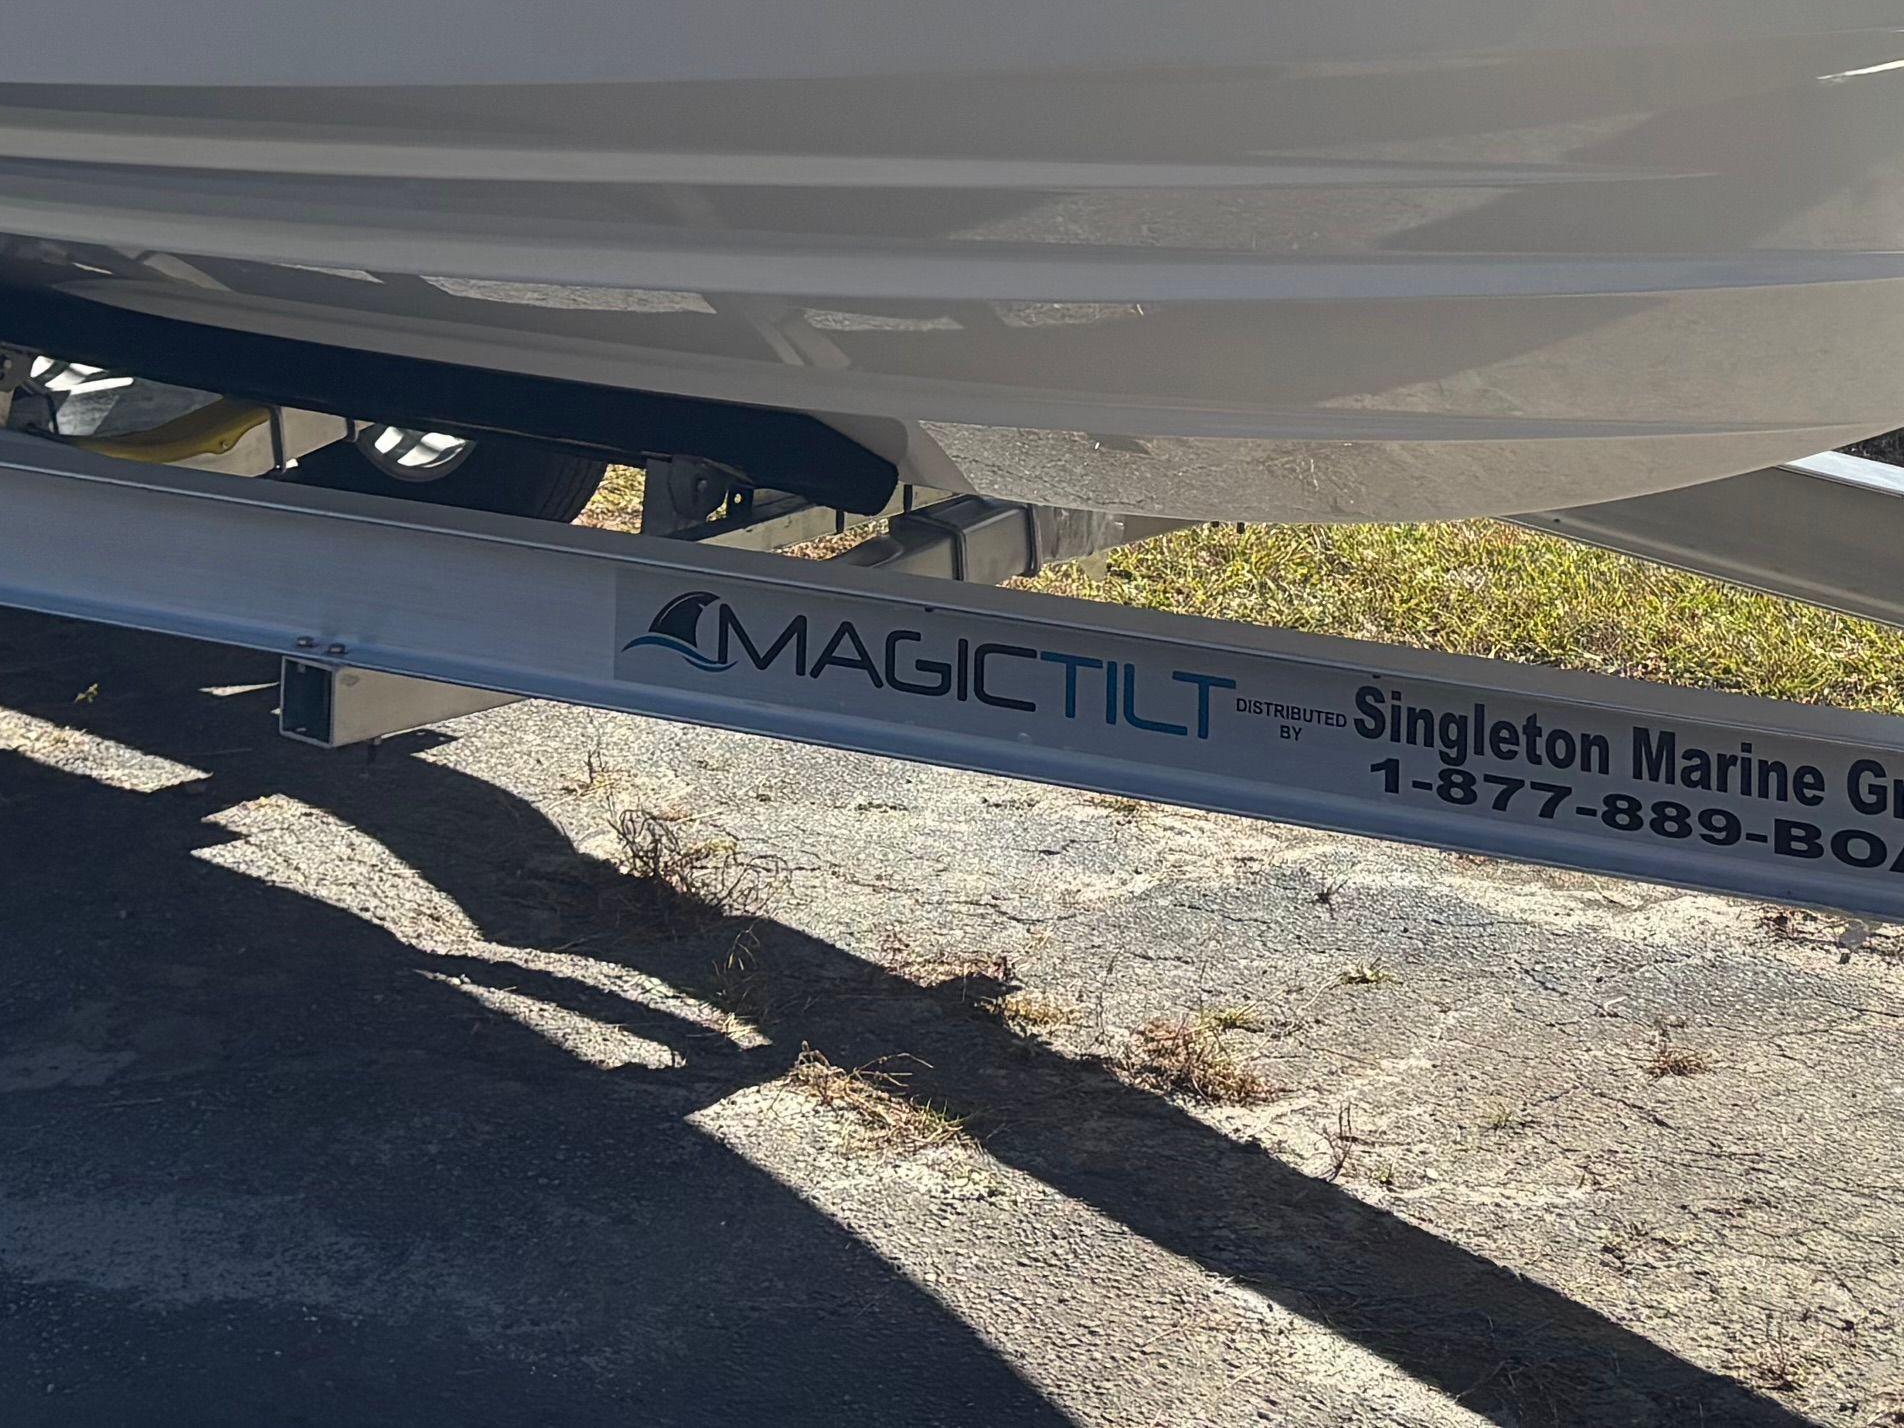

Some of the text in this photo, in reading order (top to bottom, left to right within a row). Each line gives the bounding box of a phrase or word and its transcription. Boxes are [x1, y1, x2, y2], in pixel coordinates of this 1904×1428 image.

[717, 602, 1237, 740] MAGICTILT
[1235, 697, 1348, 729] DISTRIBUTED
[1279, 724, 1303, 742] BY
[1353, 685, 1610, 776] Singleton
[1631, 725, 1826, 807] Marine
